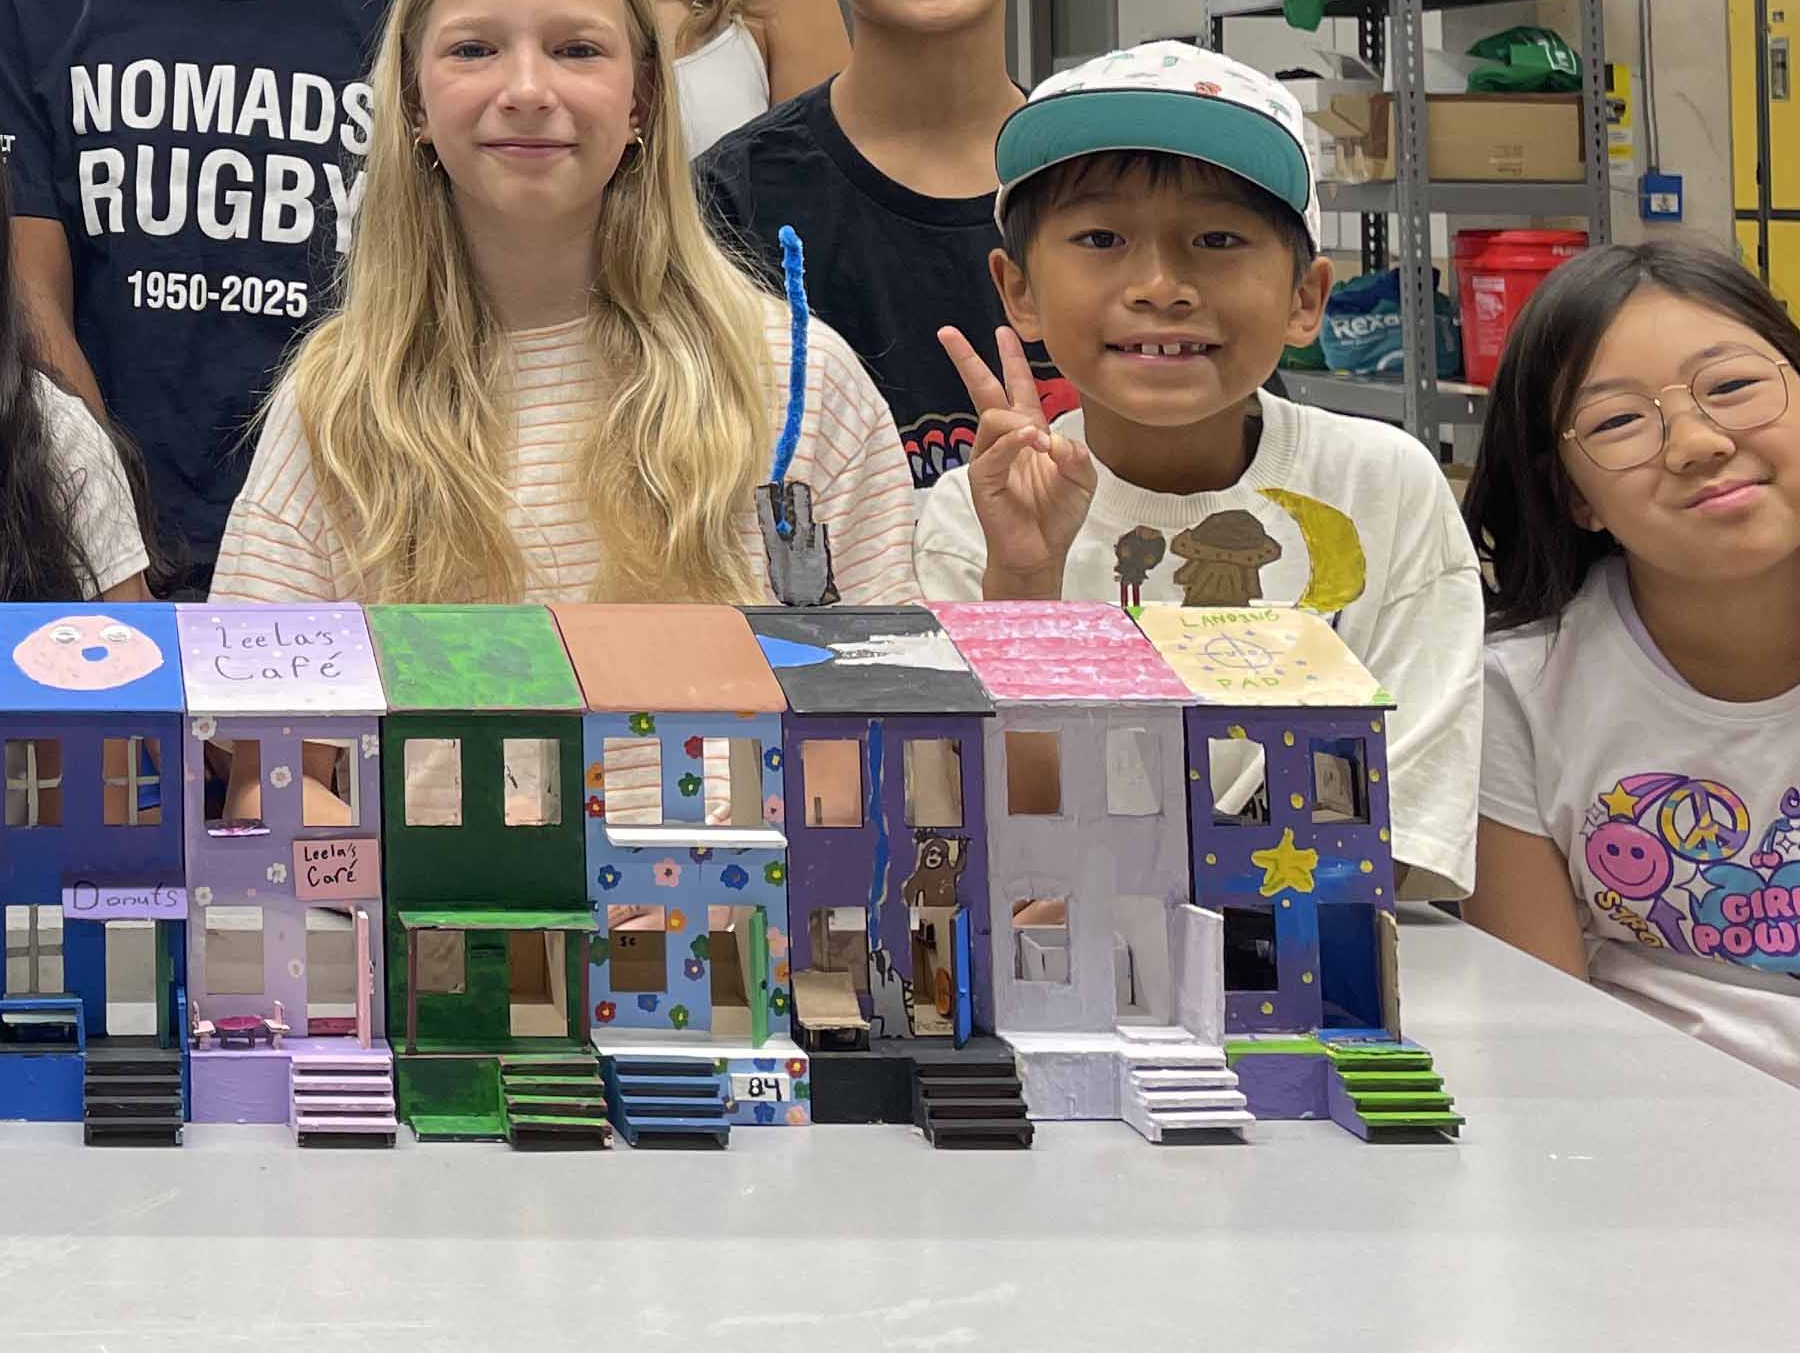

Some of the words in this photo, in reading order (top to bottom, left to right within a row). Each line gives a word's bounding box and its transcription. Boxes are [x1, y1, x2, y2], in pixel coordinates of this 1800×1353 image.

[70, 58, 375, 155] NOMADS
[78, 144, 367, 254] RUGBY
[127, 270, 308, 318] 1950-2025
[214, 651, 343, 681] Café
[1217, 677, 1280, 688] PAD
[304, 842, 357, 862] Leela's
[1692, 921, 1800, 957] POW
[749, 1077, 782, 1102] 84
